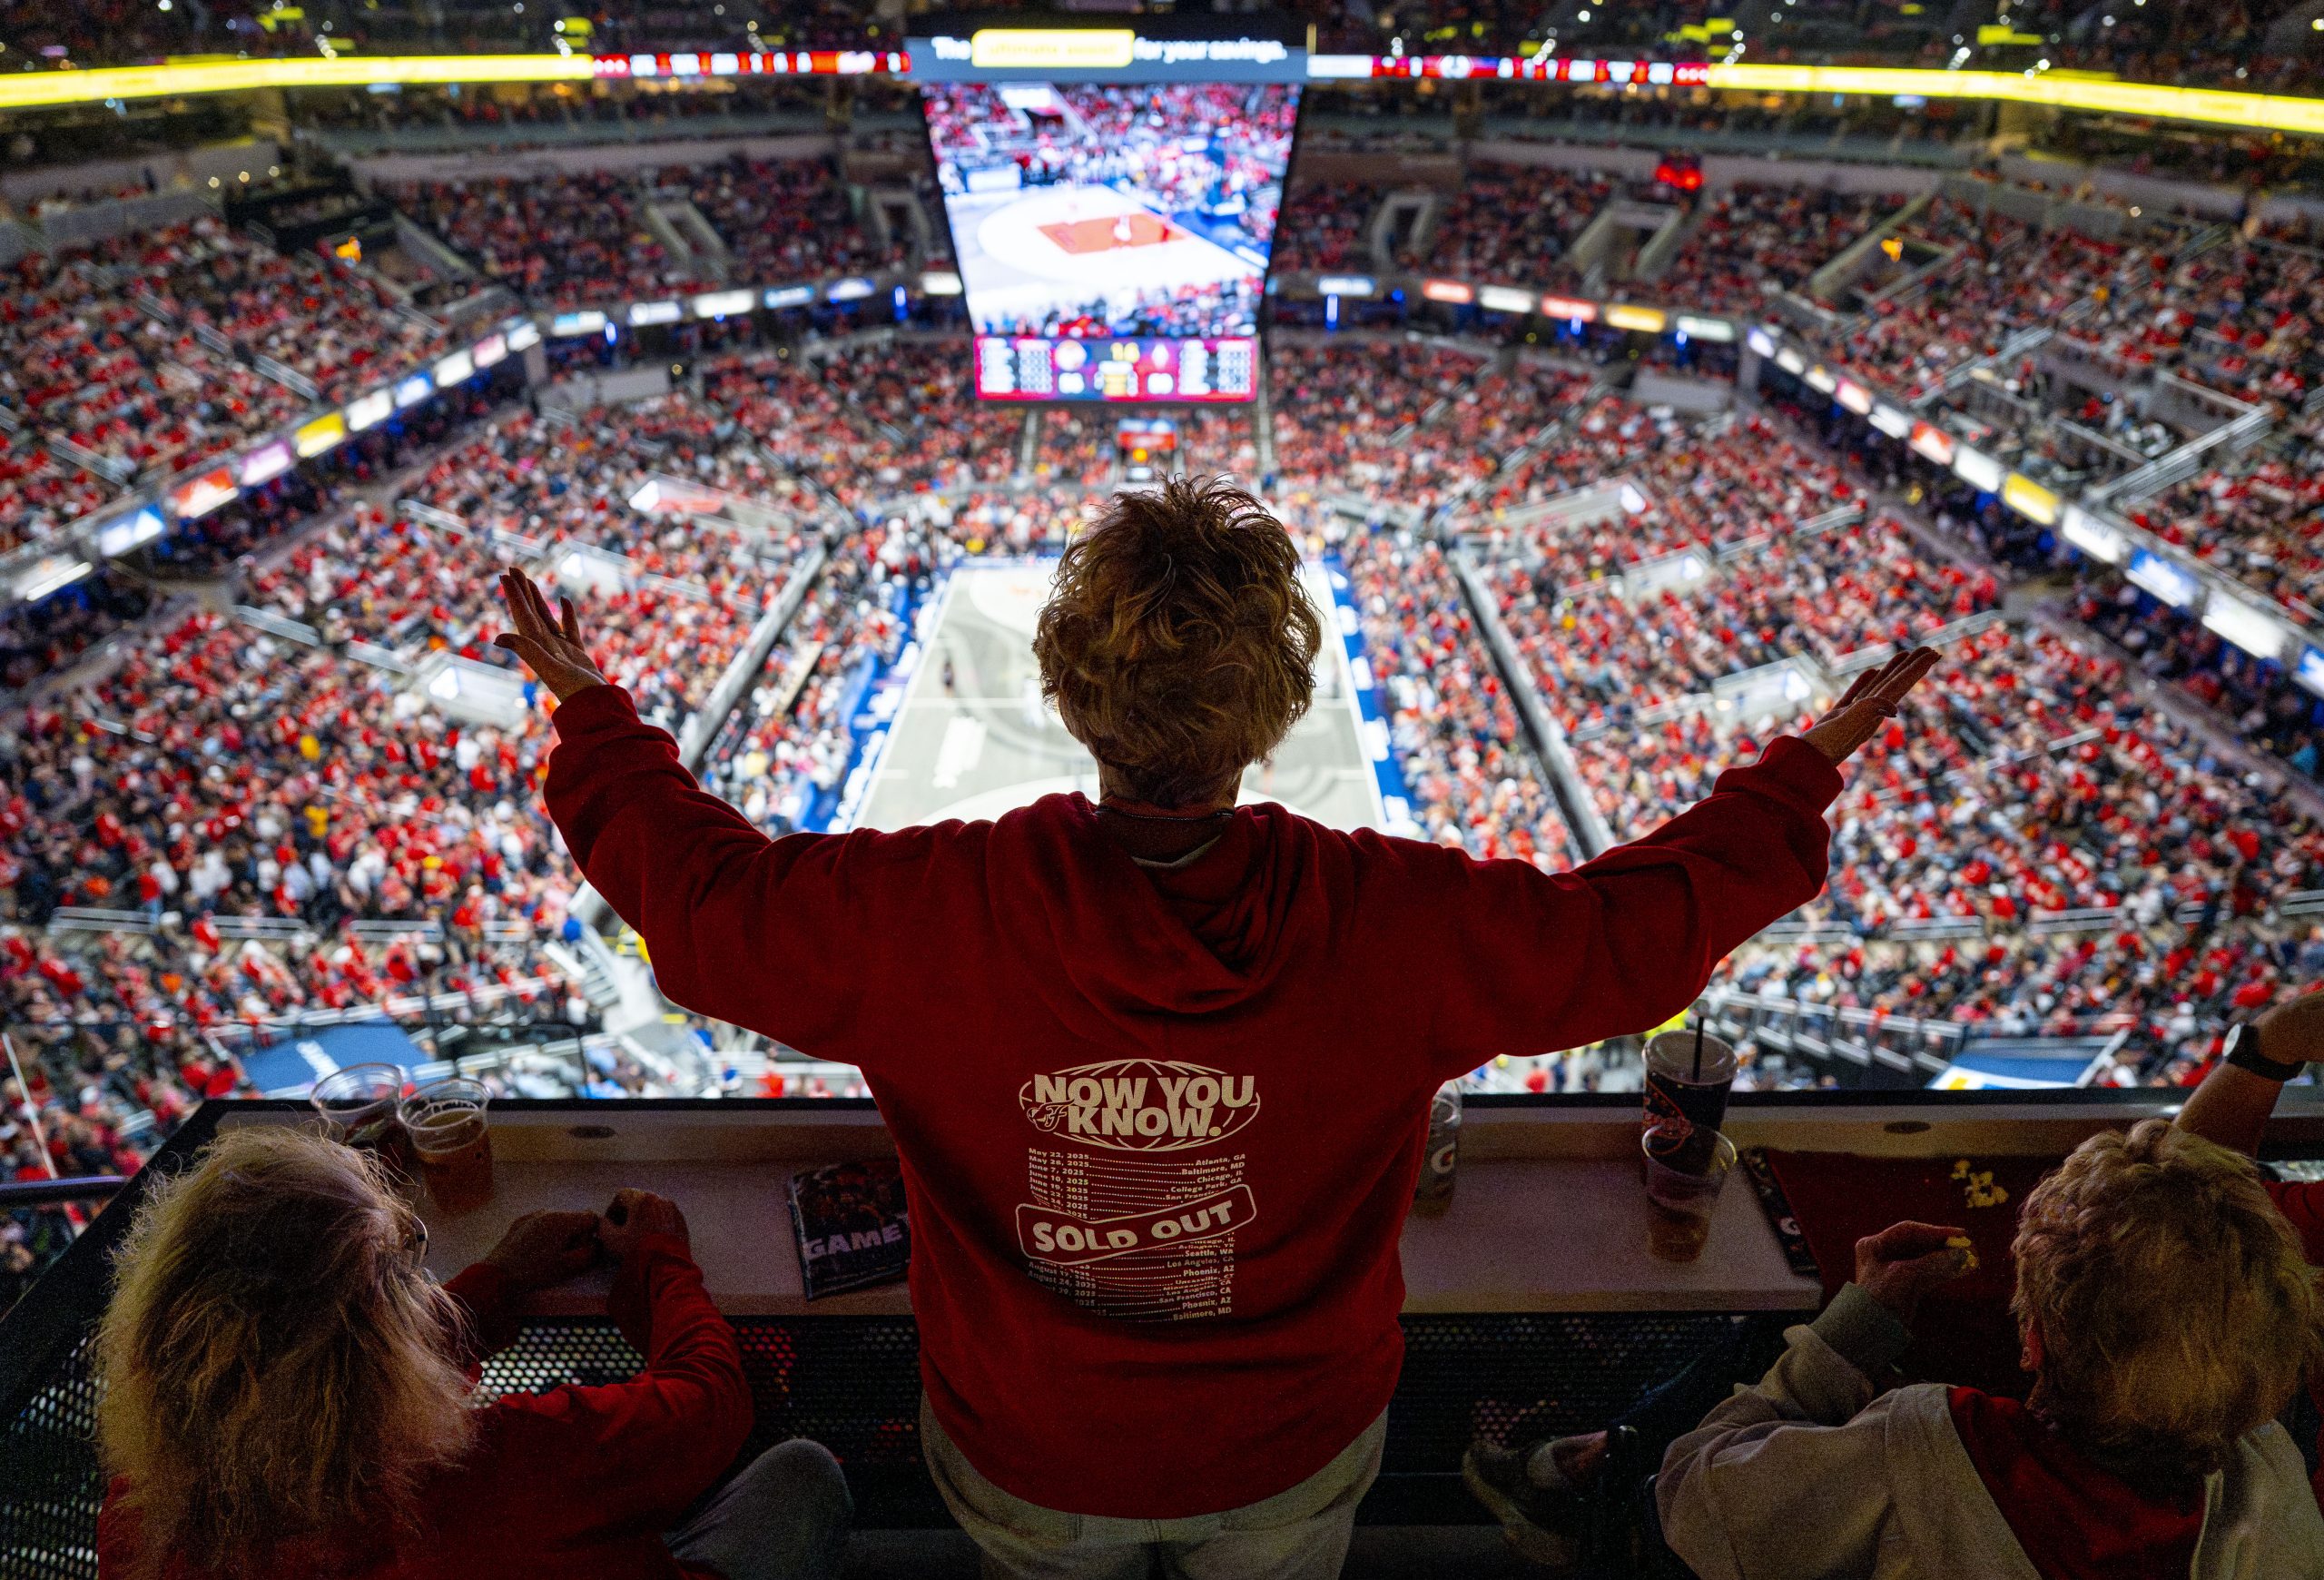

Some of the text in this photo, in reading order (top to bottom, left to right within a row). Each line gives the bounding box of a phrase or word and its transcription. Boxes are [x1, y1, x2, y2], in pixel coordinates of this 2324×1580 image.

[1164, 40, 1208, 64] your
[1034, 1073, 1255, 1110] NOW YOU
[1068, 1105, 1222, 1137] KNOW.
[1029, 1148, 1048, 1158] May
[1195, 1158, 1231, 1167] Atlanta,
[1029, 1156, 1048, 1165] May
[1181, 1167, 1227, 1175] Baltimore,
[1029, 1163, 1049, 1171] June
[1196, 1174, 1233, 1183] Chicago,
[1029, 1170, 1048, 1180] June
[1050, 1176, 1063, 1184] 10,
[1029, 1177, 1048, 1187] June
[1029, 1184, 1048, 1195] June
[1066, 1202, 1088, 1210] 2025
[1032, 1200, 1233, 1252] SOLD OUT
[803, 1223, 904, 1261] GAME
[1184, 1259, 1220, 1267] Angeles,
[1183, 1267, 1220, 1277] Phoenix,
[1075, 1281, 1097, 1289] 2025
[1177, 1291, 1218, 1301] Francisco,
[1182, 1299, 1218, 1309] Phoenix,
[1173, 1310, 1216, 1321] Baltimore,
